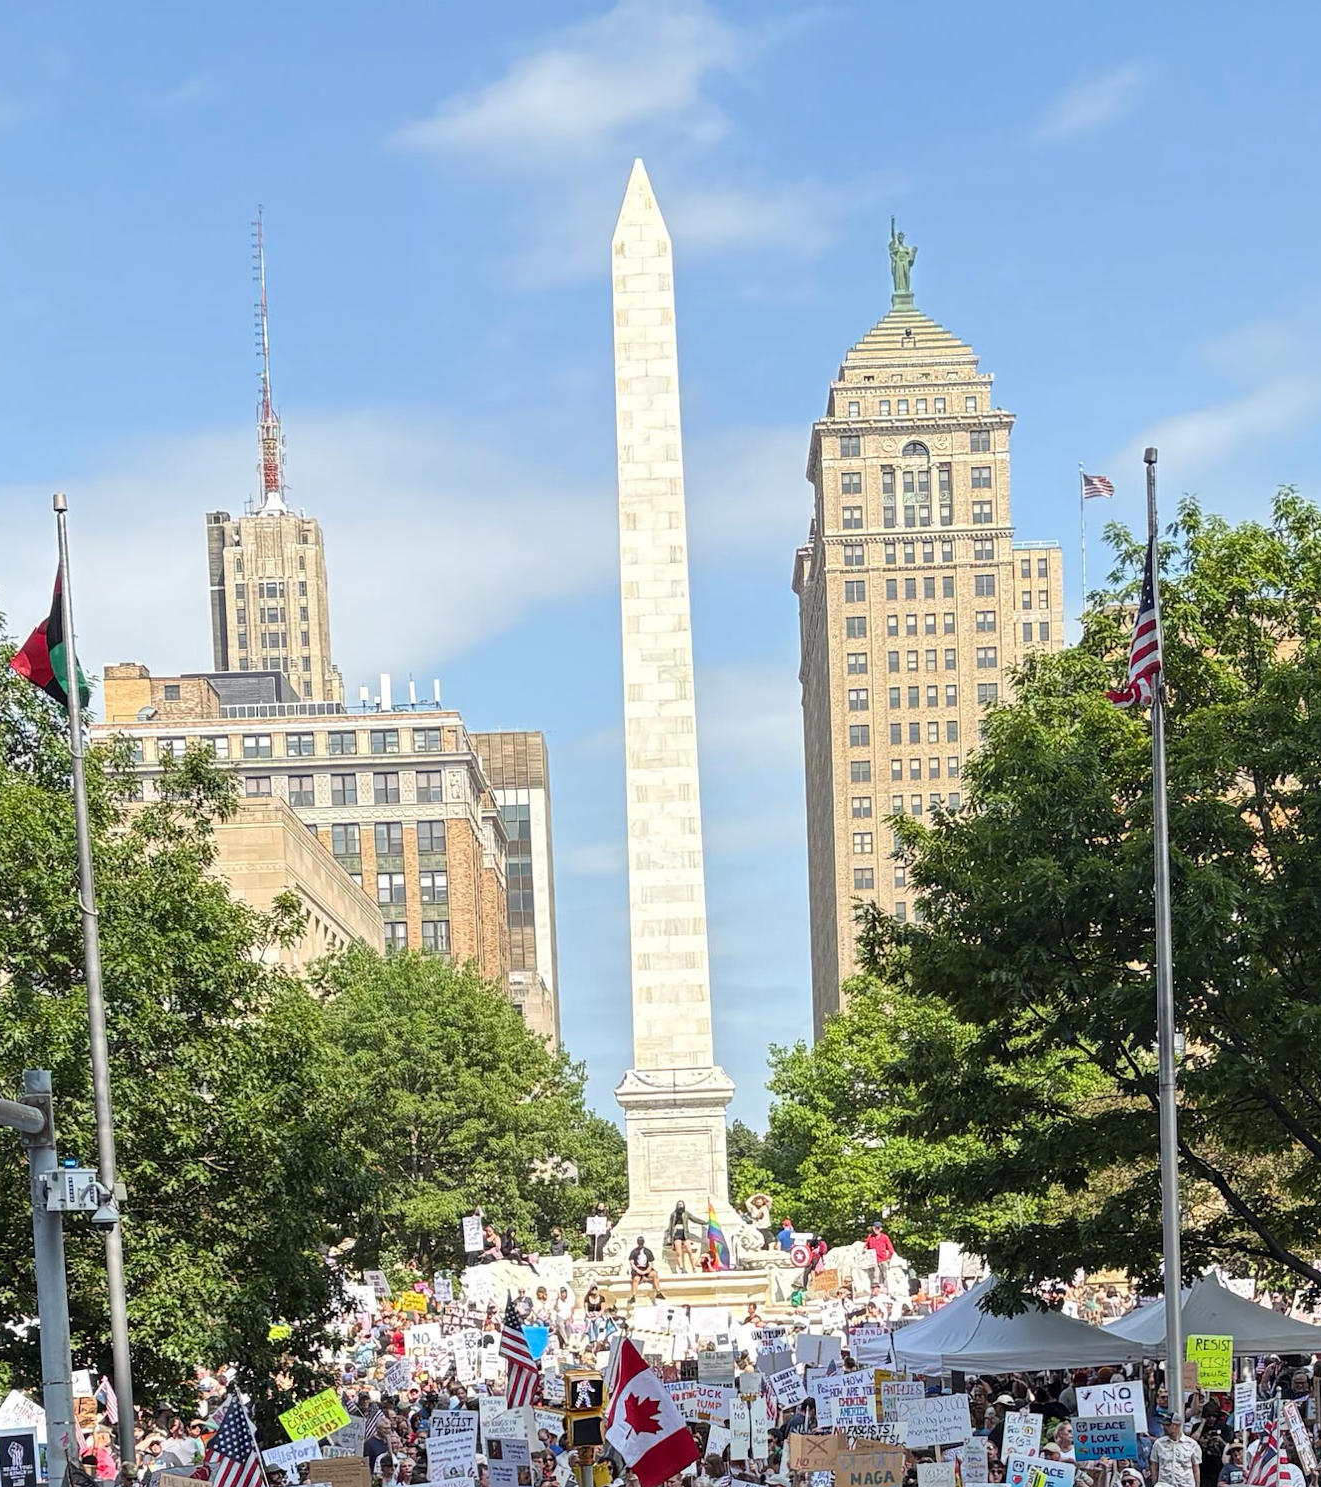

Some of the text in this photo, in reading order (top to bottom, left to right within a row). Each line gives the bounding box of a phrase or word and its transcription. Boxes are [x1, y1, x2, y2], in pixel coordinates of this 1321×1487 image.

[856, 1327, 885, 1337] STAND
[412, 1333, 430, 1345] NO
[1195, 1338, 1232, 1352] RESIST
[842, 1374, 864, 1386] HOW
[846, 1387, 860, 1396] ARE
[1103, 1387, 1132, 1401] NO
[788, 1396, 801, 1404] ALL
[839, 1406, 868, 1417] AMERICA
[1095, 1401, 1135, 1416] KING
[287, 1400, 338, 1429] CORRUPTION
[432, 1417, 474, 1429] FASCIST
[1090, 1421, 1127, 1431] PEACE
[847, 1424, 896, 1435] FASCISTS!
[1091, 1434, 1120, 1443] LOVE
[1092, 1446, 1125, 1455] UNITY
[795, 1457, 810, 1468] NO
[850, 1470, 896, 1486] MAGA
